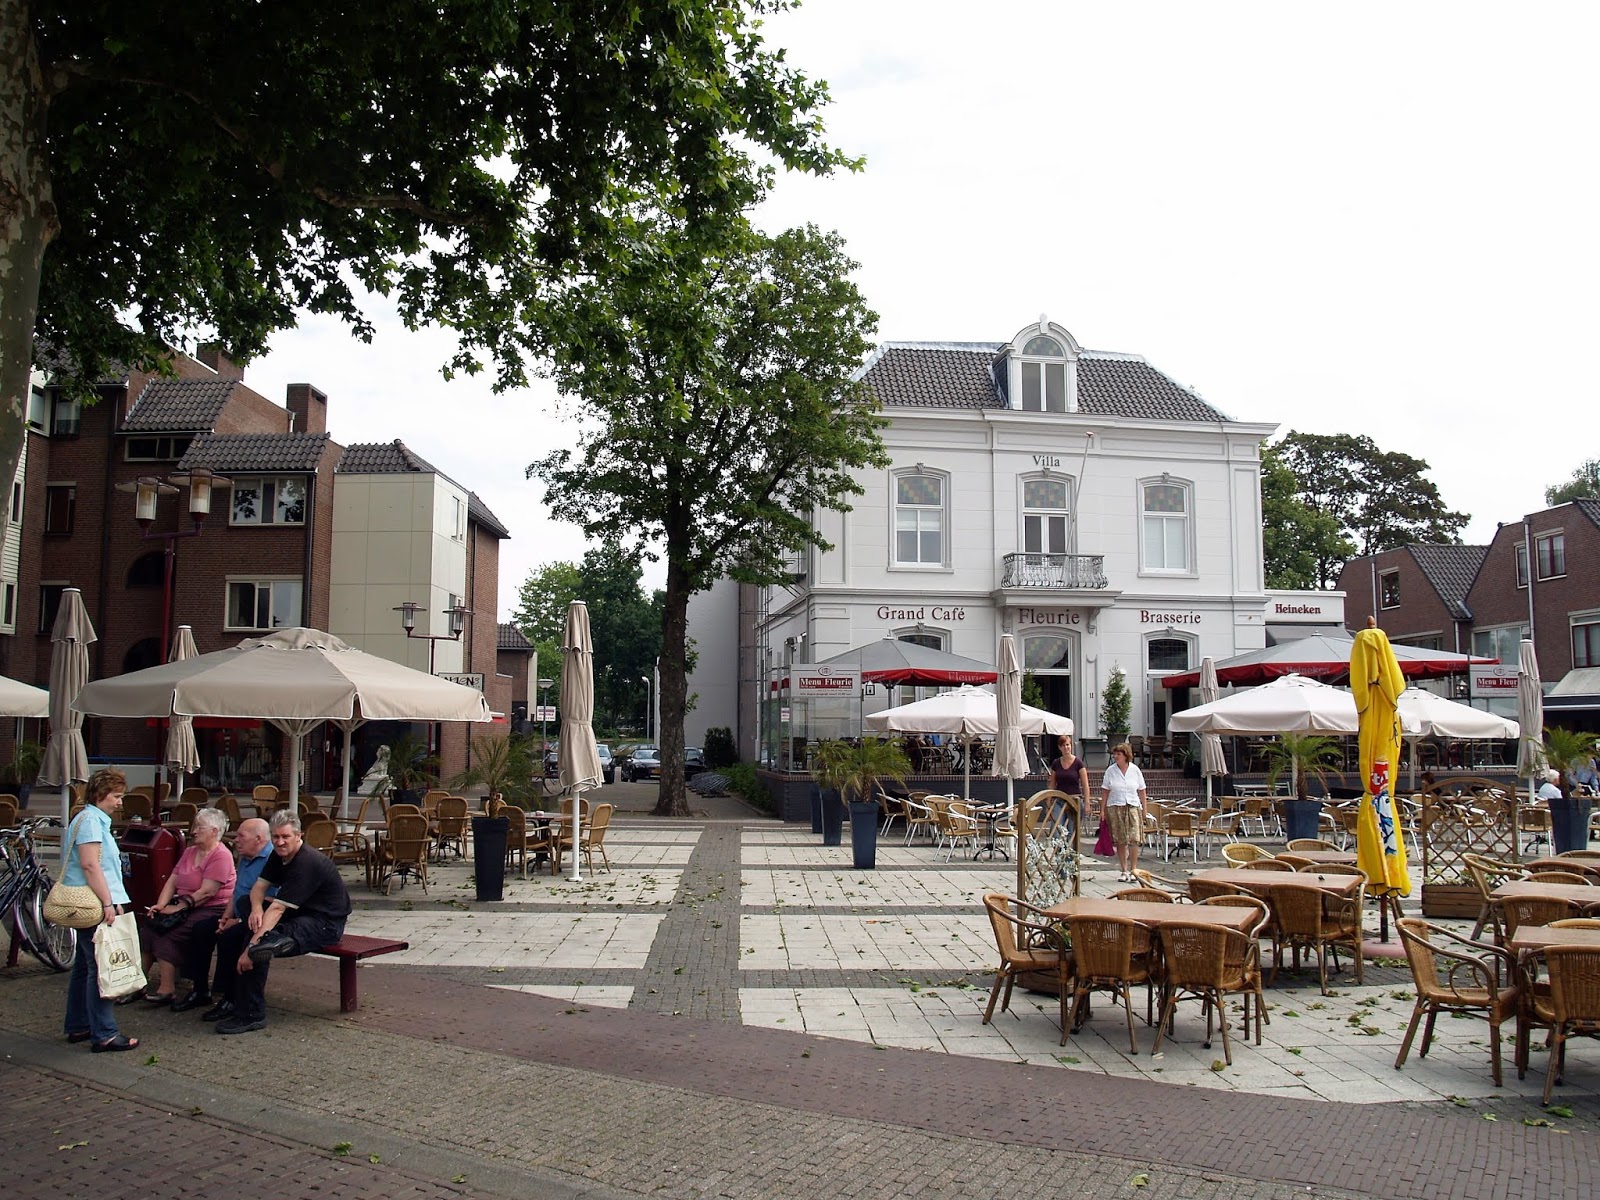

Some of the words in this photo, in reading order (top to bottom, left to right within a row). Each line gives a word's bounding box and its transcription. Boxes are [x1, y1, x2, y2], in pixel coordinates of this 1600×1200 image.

[1033, 455, 1060, 467] Villa
[877, 606, 925, 620] Grand
[931, 607, 966, 620] Café
[1275, 603, 1321, 614] Heineken
[1018, 608, 1080, 624] Fleurie
[1140, 610, 1201, 624] Brasserie
[800, 678, 822, 686] Menu
[825, 678, 852, 686] Fleurie
[948, 672, 985, 681] Fleurie
